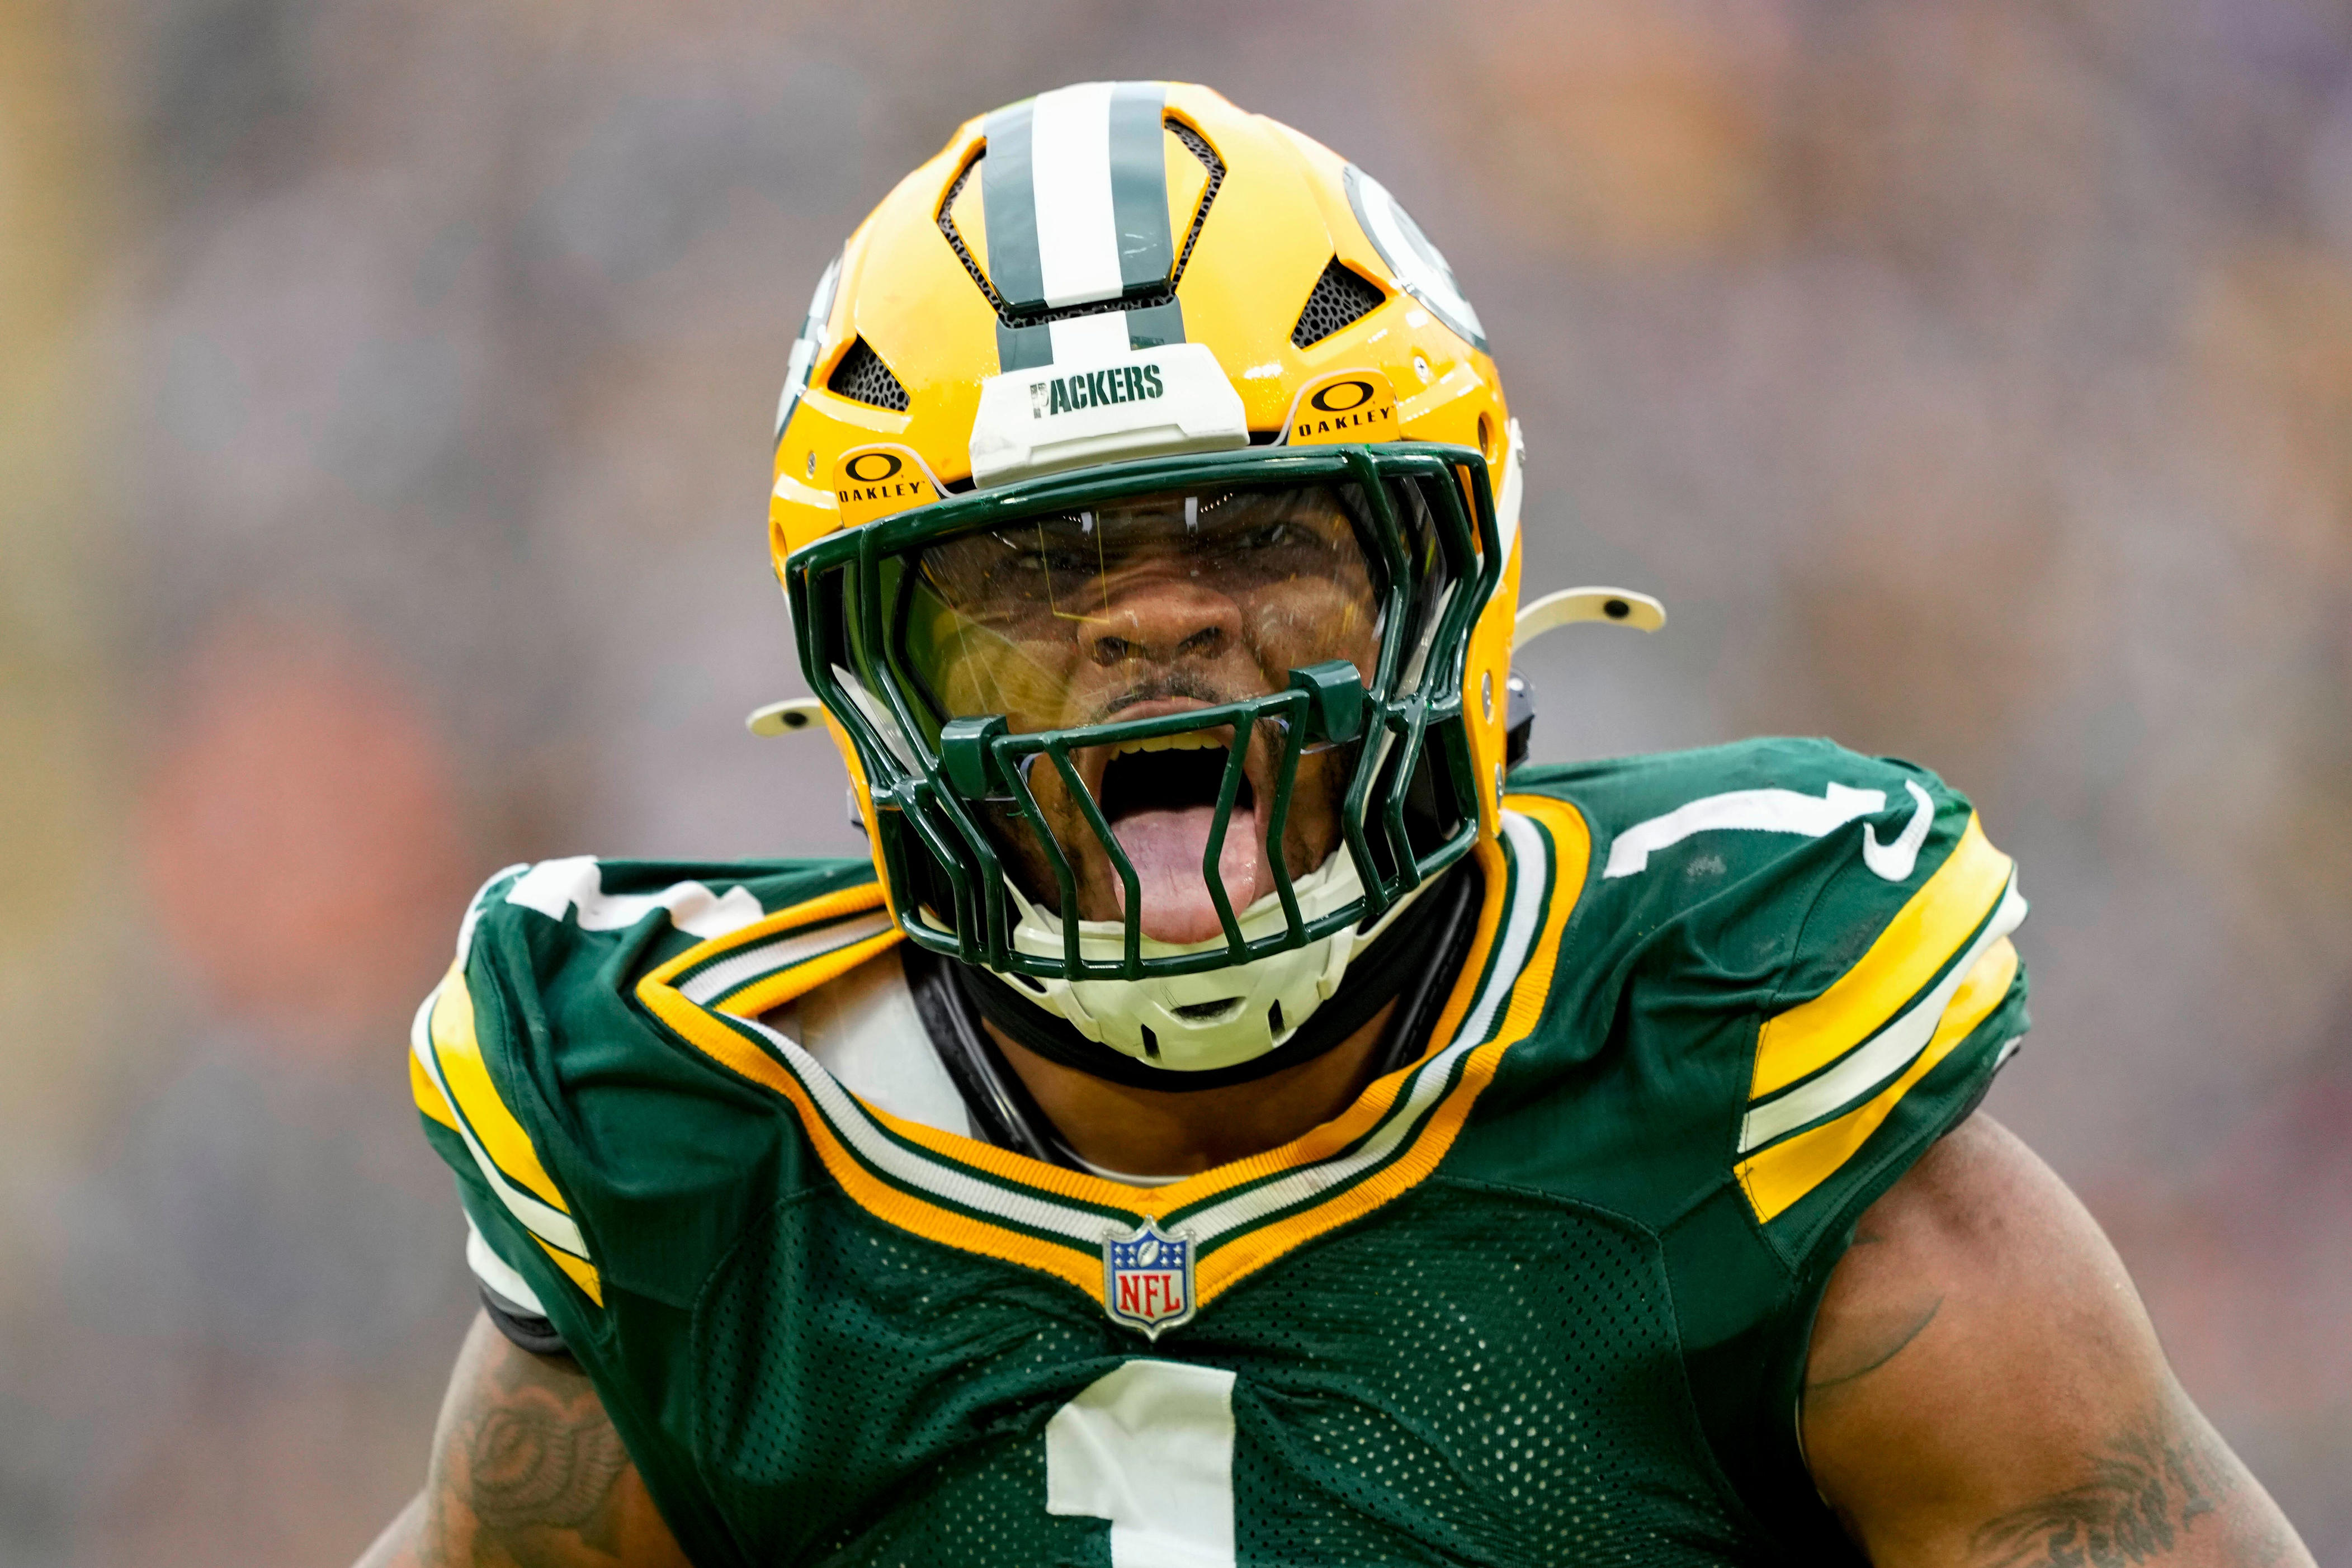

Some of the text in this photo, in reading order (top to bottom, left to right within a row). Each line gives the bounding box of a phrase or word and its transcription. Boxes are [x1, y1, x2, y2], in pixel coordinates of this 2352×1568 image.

[1030, 364, 1164, 419] PACKERS
[1298, 407, 1390, 437] OAKLEY
[839, 481, 920, 503] OAKLEY
[1118, 1274, 1180, 1318] NFL
